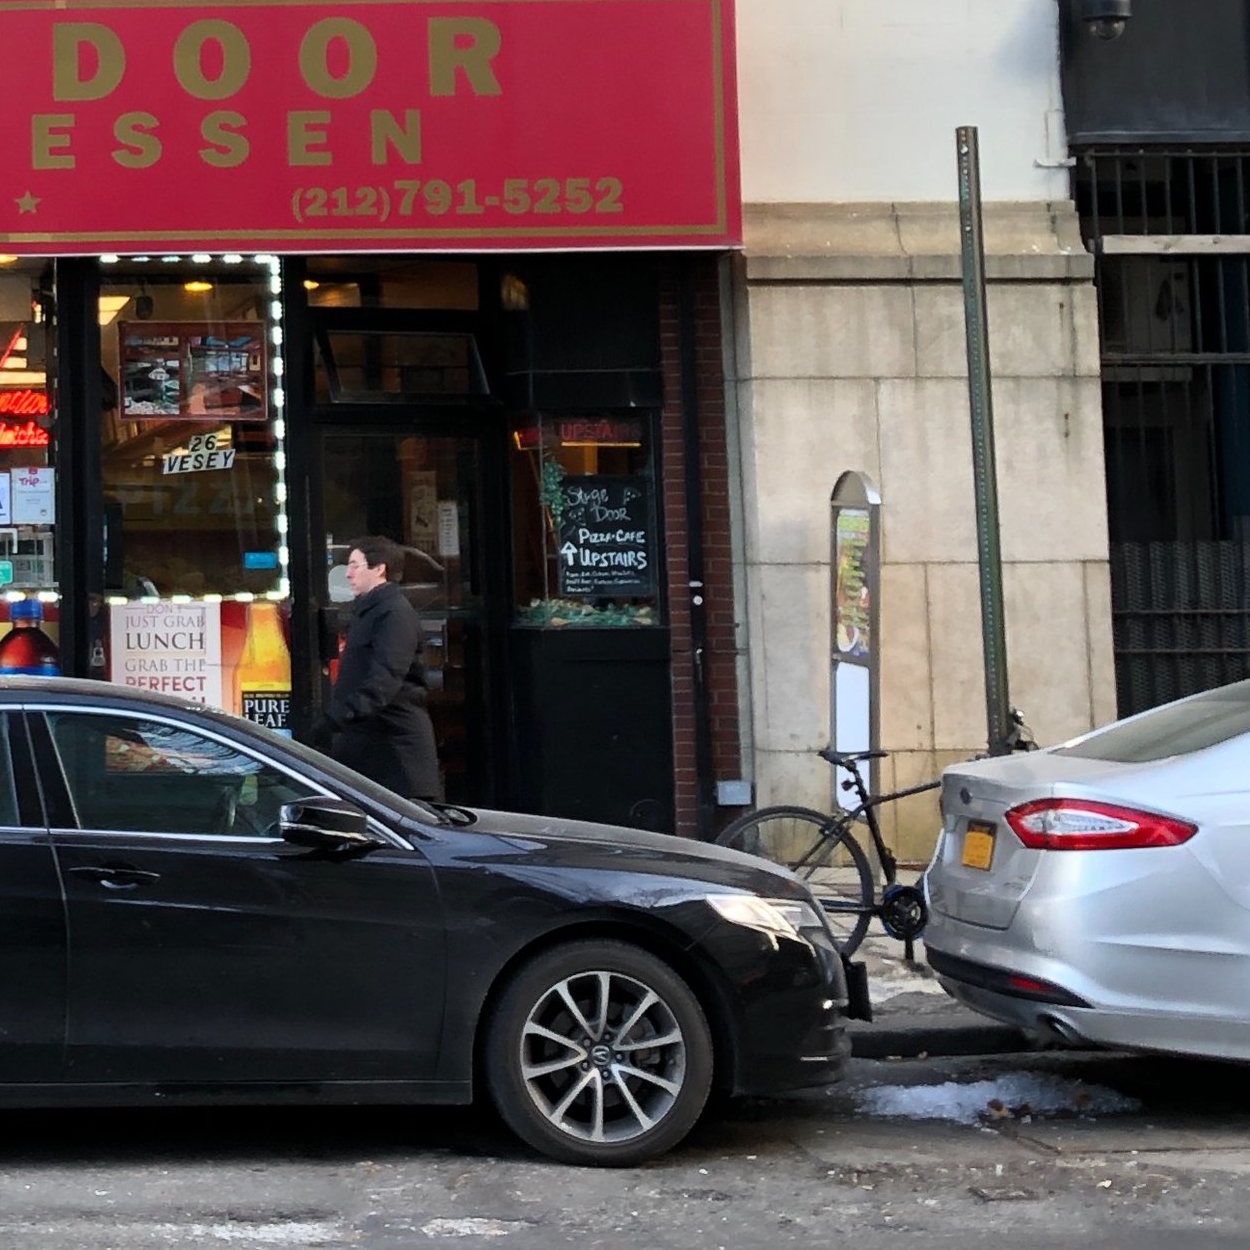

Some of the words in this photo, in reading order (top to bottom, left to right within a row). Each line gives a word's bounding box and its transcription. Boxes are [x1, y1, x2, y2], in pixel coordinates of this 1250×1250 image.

[51, 15, 503, 103] DOOR
[291, 176, 625, 222] (212)791-5252
[190, 435, 217, 453] 26
[166, 450, 234, 473] VESEY
[146, 604, 182, 615] DONT
[126, 615, 159, 629] JUST
[164, 615, 206, 628] GRAB
[126, 632, 205, 650] LUNCH
[124, 658, 169, 673] GRAB
[173, 658, 206, 672] THE
[126, 676, 207, 692] PERFECT
[243, 699, 291, 714] PURE
